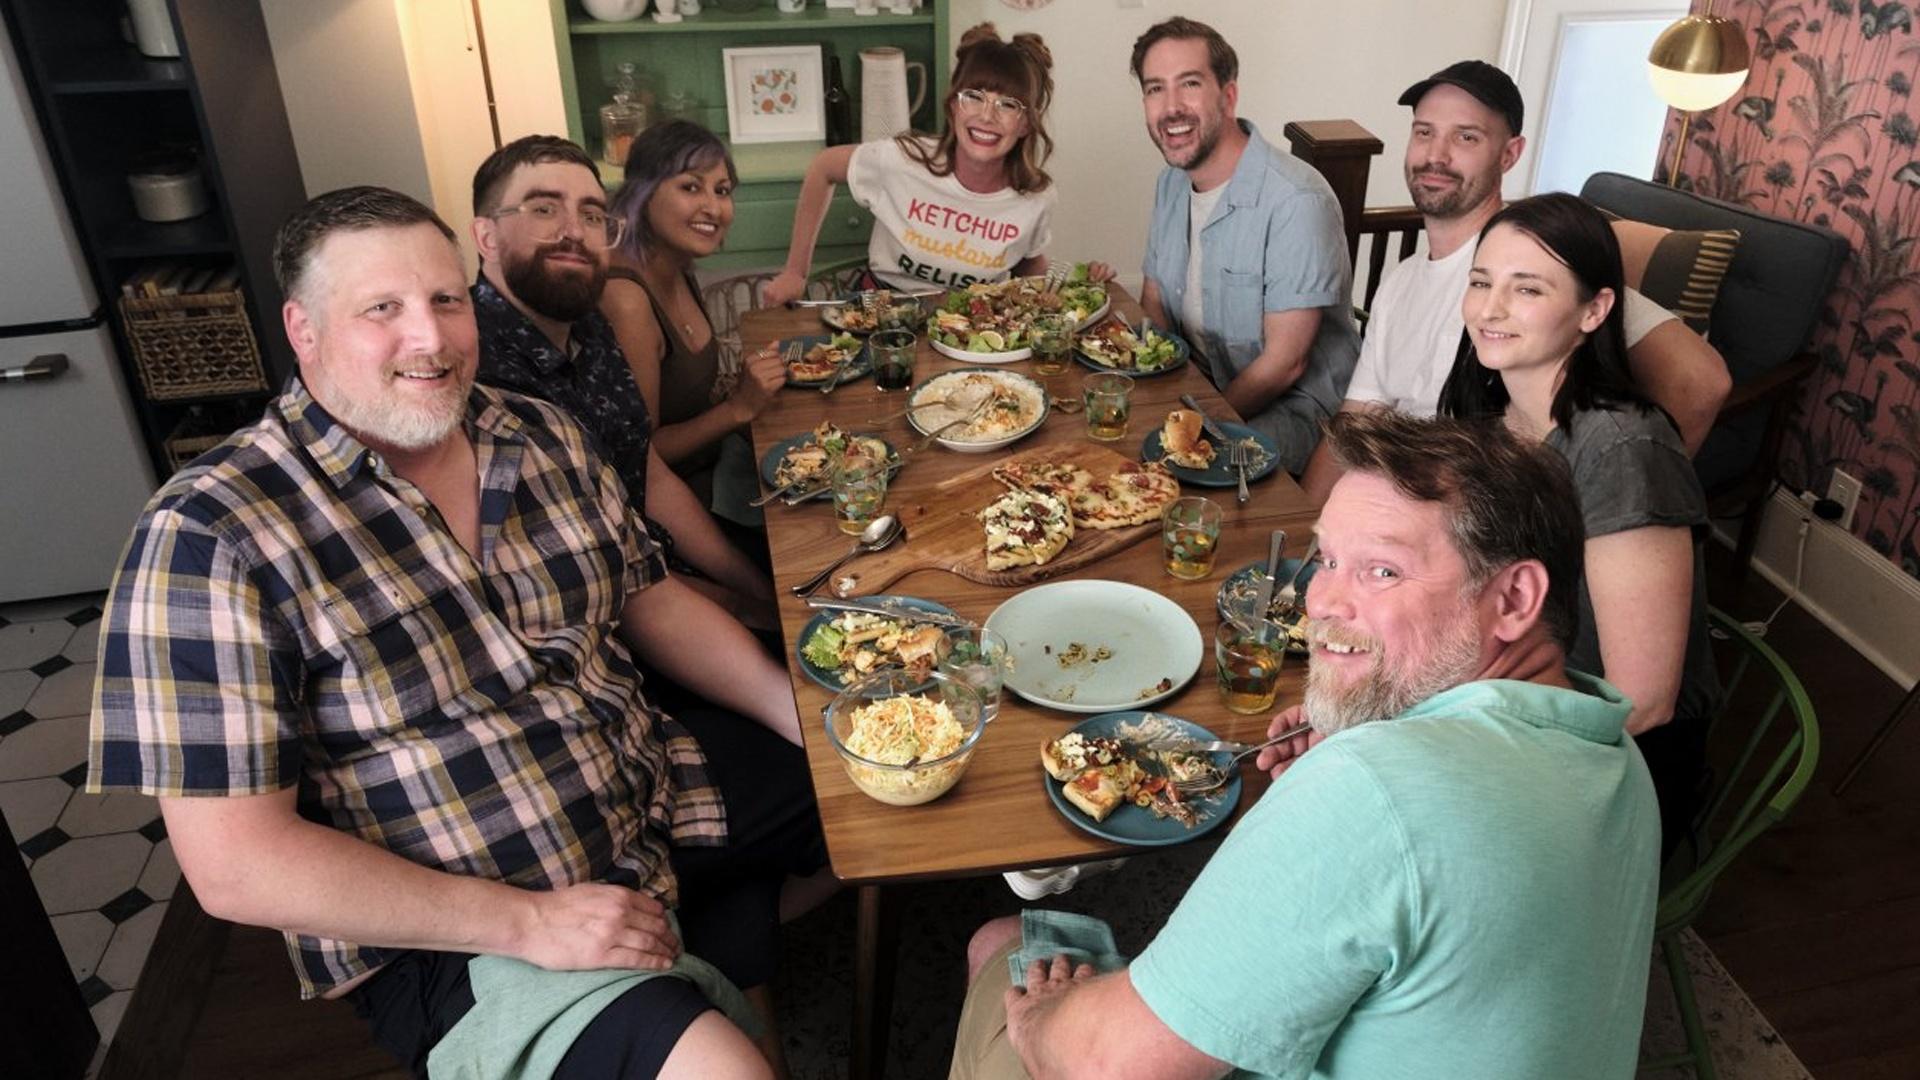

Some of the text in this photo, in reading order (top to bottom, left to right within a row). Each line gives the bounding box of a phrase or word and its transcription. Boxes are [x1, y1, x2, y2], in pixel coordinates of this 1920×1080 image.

[908, 198, 1019, 242] KETCHUP
[904, 228, 1007, 268] mustard
[898, 254, 996, 289] RELIS
